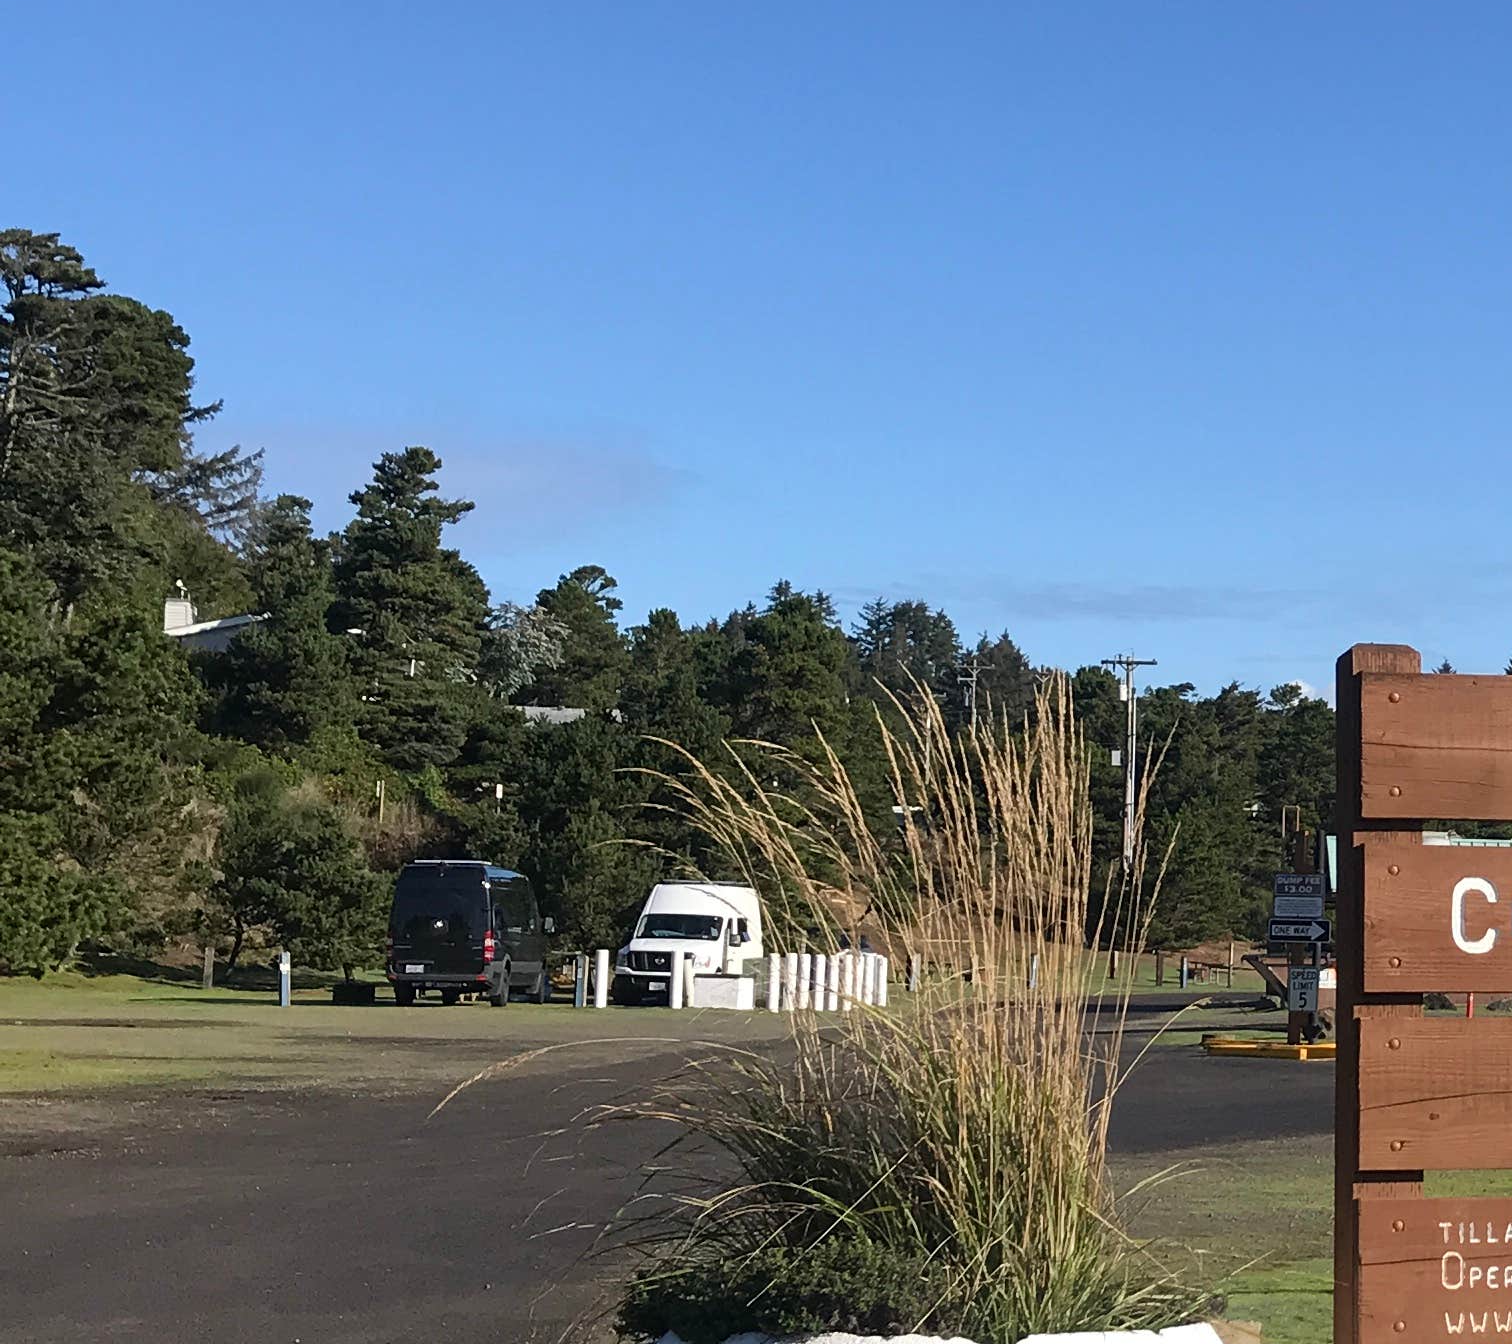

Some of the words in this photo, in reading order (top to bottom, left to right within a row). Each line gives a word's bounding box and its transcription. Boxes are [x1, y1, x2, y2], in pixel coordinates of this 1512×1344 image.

[1274, 926, 1291, 934] ONE
[1293, 926, 1310, 934] WAY
[1291, 970, 1317, 980] SPEED
[1293, 981, 1314, 990] LIMIT
[1298, 991, 1307, 1008] 5
